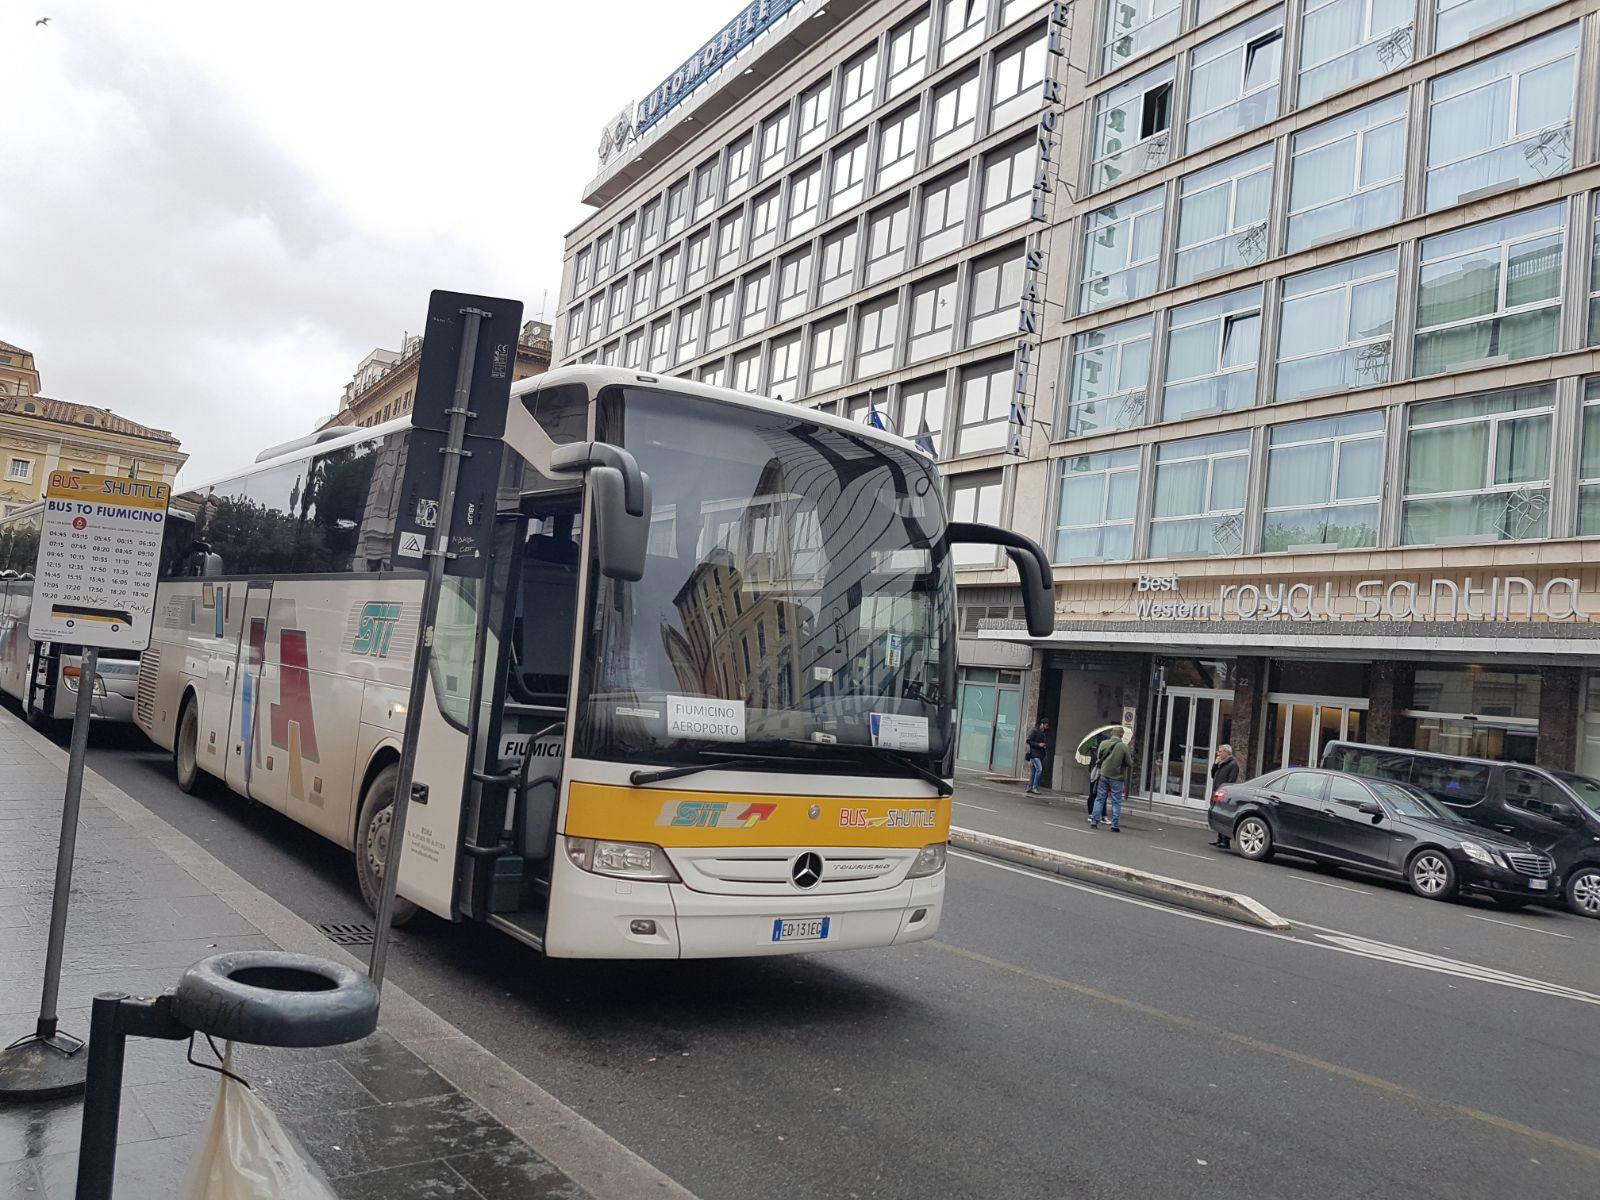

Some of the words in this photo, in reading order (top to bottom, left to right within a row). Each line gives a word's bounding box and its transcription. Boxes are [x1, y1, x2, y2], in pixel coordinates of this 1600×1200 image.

[1031, 77, 1062, 223] ROYAL
[1006, 247, 1044, 457] SANTINA
[52, 474, 81, 489] BUS
[103, 480, 166, 499] SHUTTLE
[48, 500, 72, 512] BUS
[77, 503, 93, 514] TO
[96, 506, 163, 522] FIUMICINO
[1138, 573, 1179, 592] Best
[1218, 581, 1341, 620] royal
[1355, 576, 1591, 621] santina
[1135, 599, 1211, 619] Western
[676, 704, 734, 718] FIUMICINO
[673, 721, 738, 735] AEROPORTO
[505, 742, 563, 757] FIUMICI
[839, 808, 869, 827] BUS
[887, 809, 936, 828] SHUTTLE
